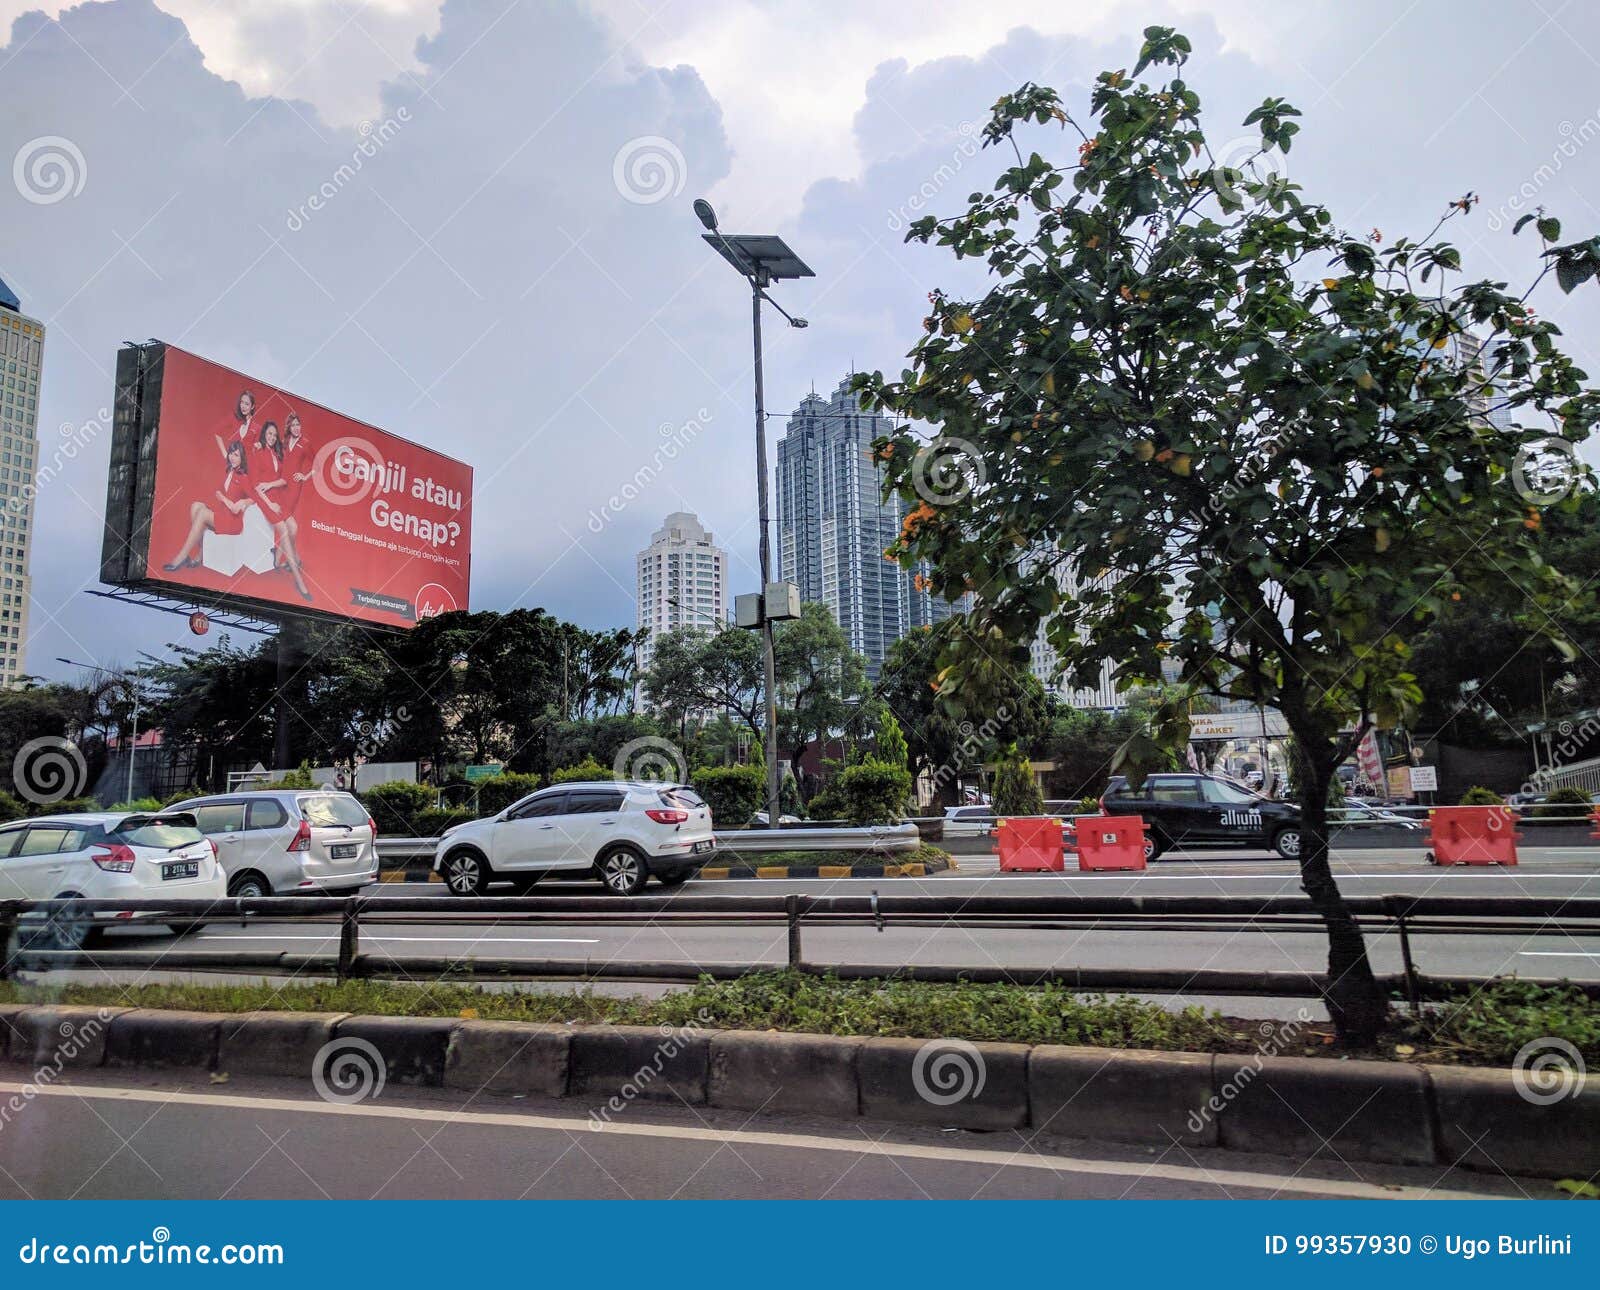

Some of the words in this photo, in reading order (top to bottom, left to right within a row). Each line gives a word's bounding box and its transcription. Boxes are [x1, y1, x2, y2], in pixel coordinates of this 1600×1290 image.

[334, 445, 407, 494] Ganjil
[411, 477, 462, 511] atau
[370, 499, 461, 548] Genap?
[311, 519, 336, 534] Bebas!
[336, 526, 363, 542] Tanggal
[363, 534, 387, 549] berapa
[387, 541, 398, 552] aja
[397, 545, 422, 559] terbang
[422, 551, 445, 564] dengan
[444, 557, 460, 566] kami
[357, 594, 381, 607] Terbang
[1204, 726, 1235, 735] JAKET
[1220, 808, 1263, 826] allium
